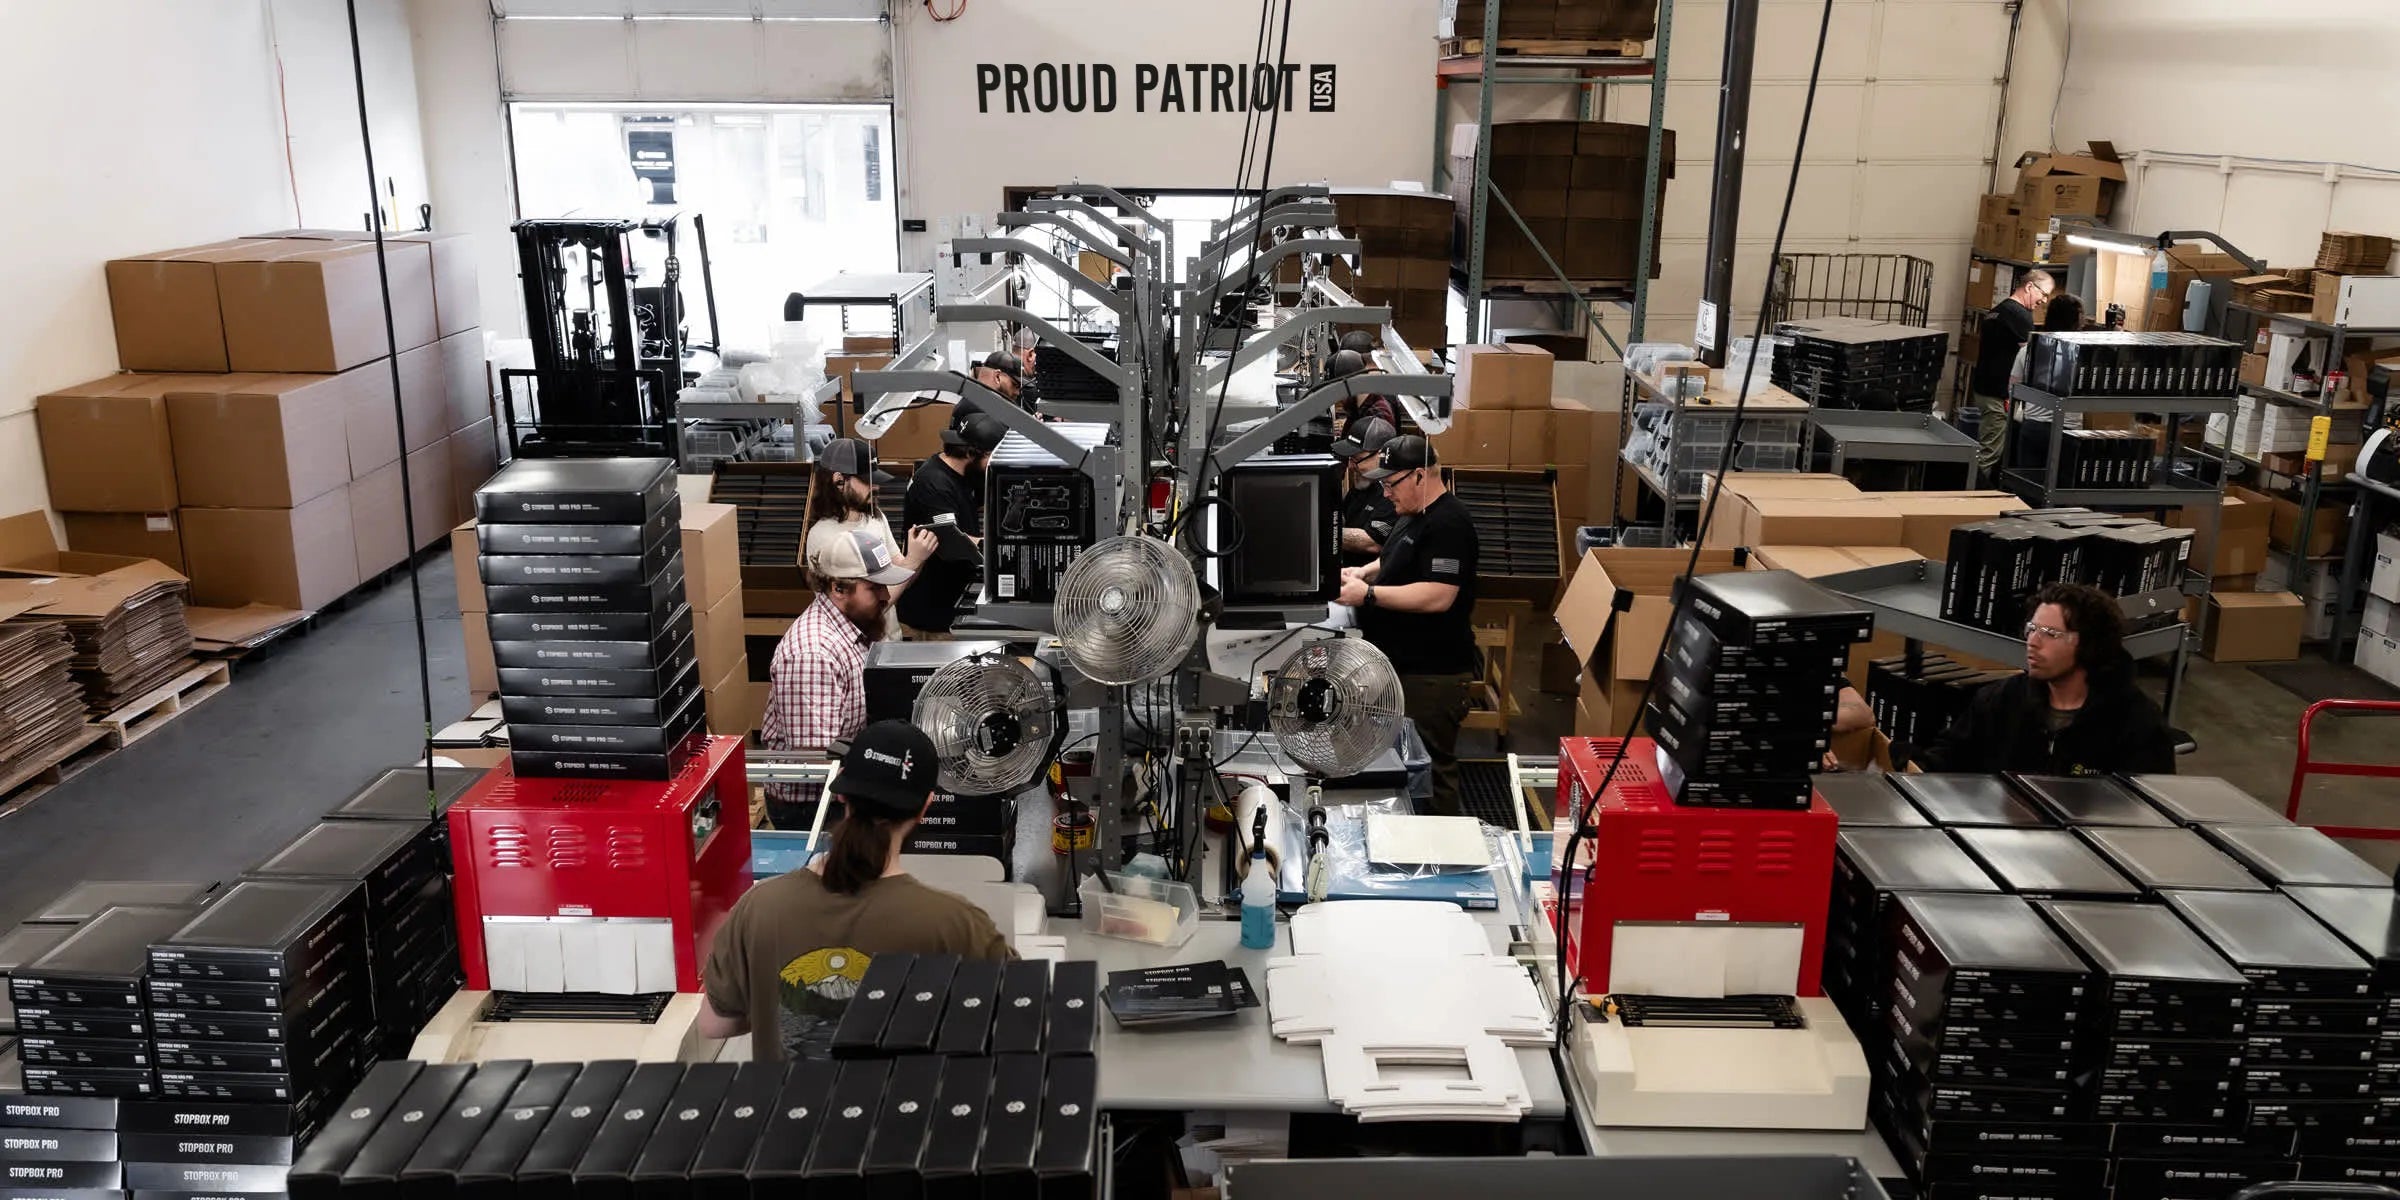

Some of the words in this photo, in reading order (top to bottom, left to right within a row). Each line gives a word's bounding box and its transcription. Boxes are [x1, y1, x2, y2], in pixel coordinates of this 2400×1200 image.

[976, 62, 1117, 113] PROUD
[1135, 62, 1301, 113] PATRIOT
[1313, 69, 1333, 107] USA
[942, 817, 956, 825] PRO
[914, 840, 942, 849] STOPBOX
[943, 841, 957, 850] PRO
[6, 1105, 42, 1116] STOPBOX
[43, 1106, 60, 1117] PRO
[174, 1114, 211, 1125] STOPBOX
[212, 1114, 230, 1125] PRO
[4, 1138, 40, 1149] STOPBOX
[41, 1139, 58, 1150] PRO
[178, 1142, 215, 1153] STOPBOX
[216, 1143, 233, 1154] PRO
[9, 1167, 45, 1178] STOPBOX
[46, 1168, 63, 1179] PRO
[183, 1170, 220, 1181] STOPBOX
[221, 1171, 239, 1182] PRO
